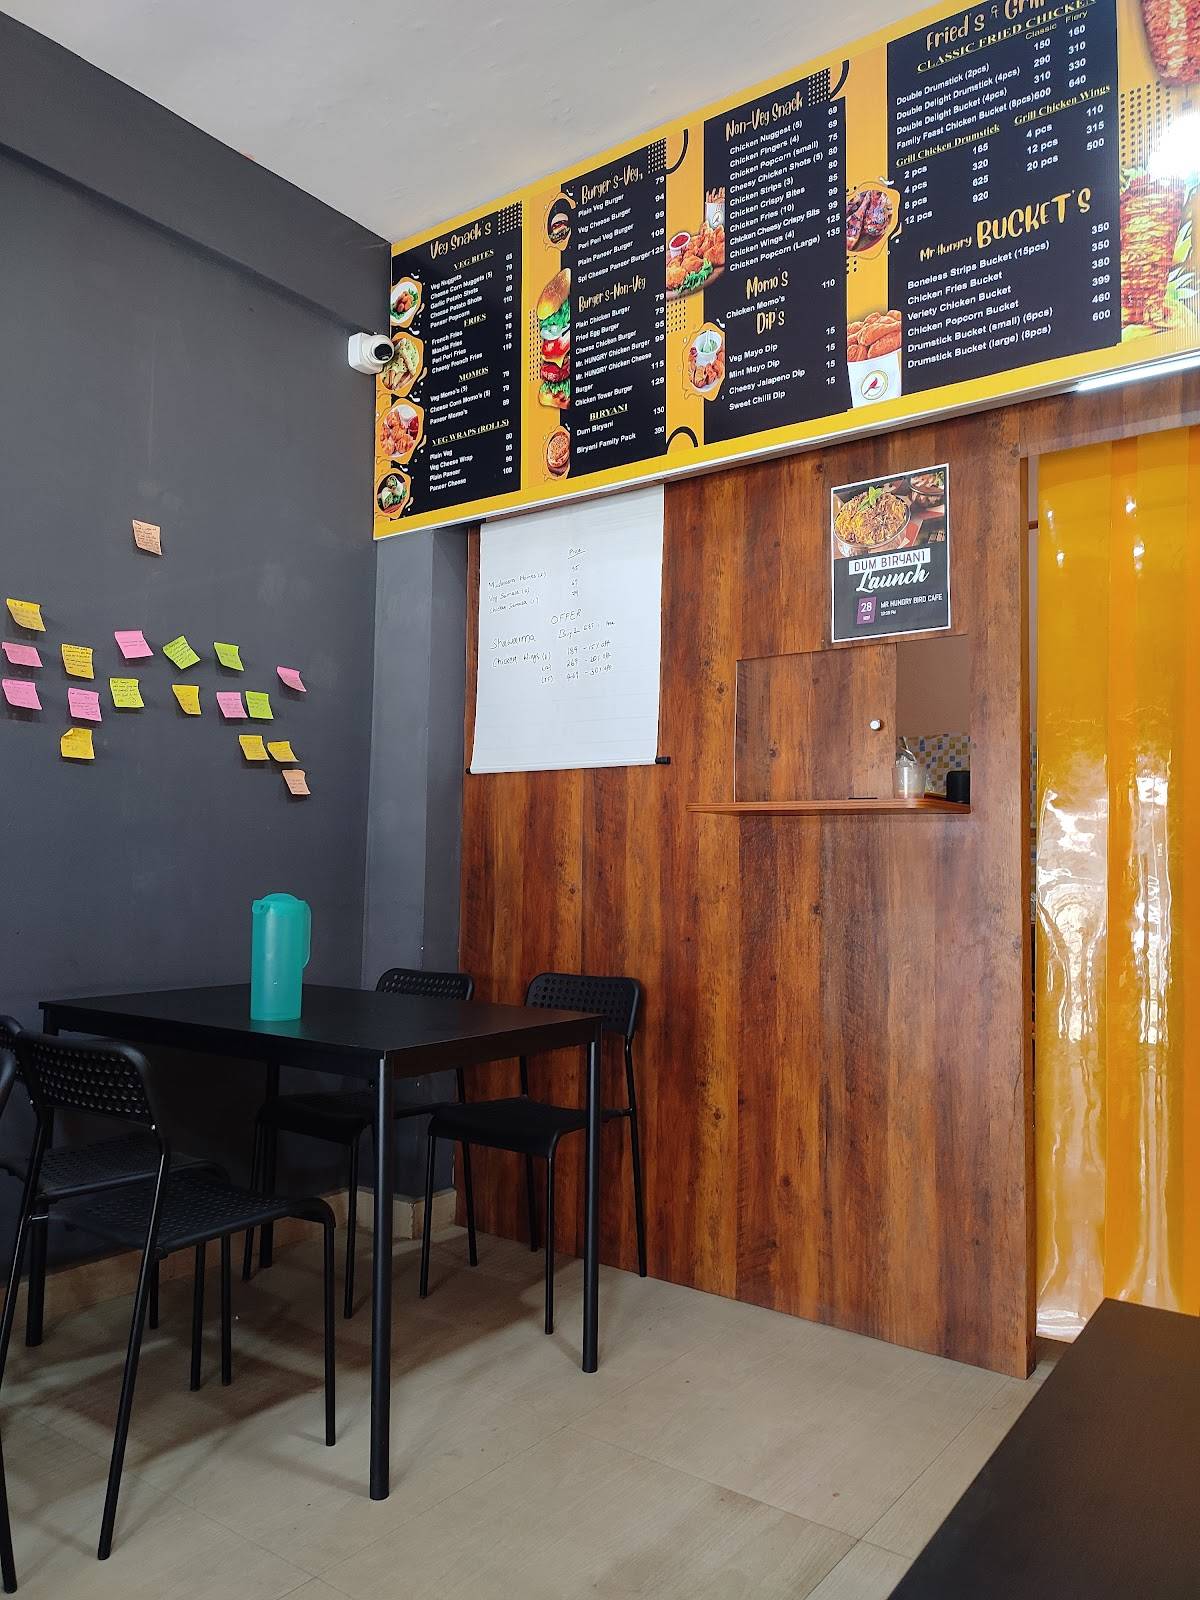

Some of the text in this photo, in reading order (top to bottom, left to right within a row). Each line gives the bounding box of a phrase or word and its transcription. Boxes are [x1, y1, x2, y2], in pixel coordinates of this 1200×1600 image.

[917, 0, 1095, 72] CLASSIC FRIED CHICKE
[1025, 23, 1057, 40] Classic
[1068, 24, 1085, 38] 160
[1068, 41, 1086, 54] 310
[1034, 54, 1051, 68] 290
[1068, 58, 1086, 71] 330
[896, 63, 989, 106] Double Drumstick (2pcs)
[1034, 70, 1051, 84] 310
[1068, 74, 1086, 88] 640
[896, 66, 1020, 120] Double Delight Drumstick (4pcs)
[896, 87, 1007, 135] Double Delight Bucket (4pcs)
[1014, 86, 1110, 125] Grill Chicken Wings
[1086, 104, 1104, 117] 110
[726, 91, 803, 142] Non-Veg Snack
[896, 135, 921, 150] Family
[923, 126, 944, 140] Feast
[945, 115, 977, 132] Chicken
[978, 103, 1007, 120] Bucket
[1086, 120, 1105, 134] 315
[729, 139, 759, 155] Chicken
[828, 132, 838, 142] 75
[896, 124, 1000, 167] Grill Chicken Drumstick
[1086, 138, 1105, 151] 500
[729, 134, 800, 168] Chicken Fingers (4)
[729, 140, 819, 181] Chicken Popcorn (small)
[972, 158, 988, 171] 320
[729, 179, 757, 194] Cheesy
[757, 167, 788, 183] Chicken
[789, 158, 812, 171] Shots
[578, 194, 624, 218] Plain Veg Burger
[655, 193, 665, 202] 94
[826, 213, 841, 224] 125
[650, 244, 665, 256] 125
[729, 229, 795, 259] Chicken Wings (4)
[729, 234, 820, 272] Chicken Popcorn (Large)
[920, 236, 972, 262] Mr Hungry
[908, 240, 1049, 290] Boneless Strips Bucket (15pcs)
[1092, 256, 1110, 269] 380
[746, 268, 788, 300] Momo's
[821, 278, 835, 289] 110
[908, 271, 1002, 305] Chicken Fries Bucket
[1092, 274, 1110, 286] 399
[726, 295, 786, 319] Chicken Momo's
[939, 296, 976, 312] Chicken
[978, 285, 1012, 302] Bucket
[1092, 291, 1110, 303] 460
[908, 299, 1019, 337] Chicken Popcorn Bucket
[908, 334, 952, 353] Drumstick
[955, 325, 987, 341] Bucket
[988, 315, 1020, 333] (small)
[575, 339, 650, 368] Mr. HUNGRY Chicken Burger
[728, 343, 778, 363] Veg Mayo Dip
[908, 350, 952, 368] Drumstick
[955, 342, 987, 357] Bucket
[988, 332, 1018, 350] (large)
[651, 376, 665, 386] 129
[574, 385, 633, 407] Chicken Tower Burger
[729, 390, 786, 411] Sweet Chilli Dip
[590, 403, 628, 421] BIRYANI
[653, 406, 665, 415] 130
[576, 432, 636, 454] Biryani Family Pack
[854, 550, 925, 572] DUM BIRYANI
[856, 563, 930, 593] Launch
[861, 601, 873, 612] 28
[928, 593, 943, 602] CAFE
[551, 609, 582, 624] OFFER
